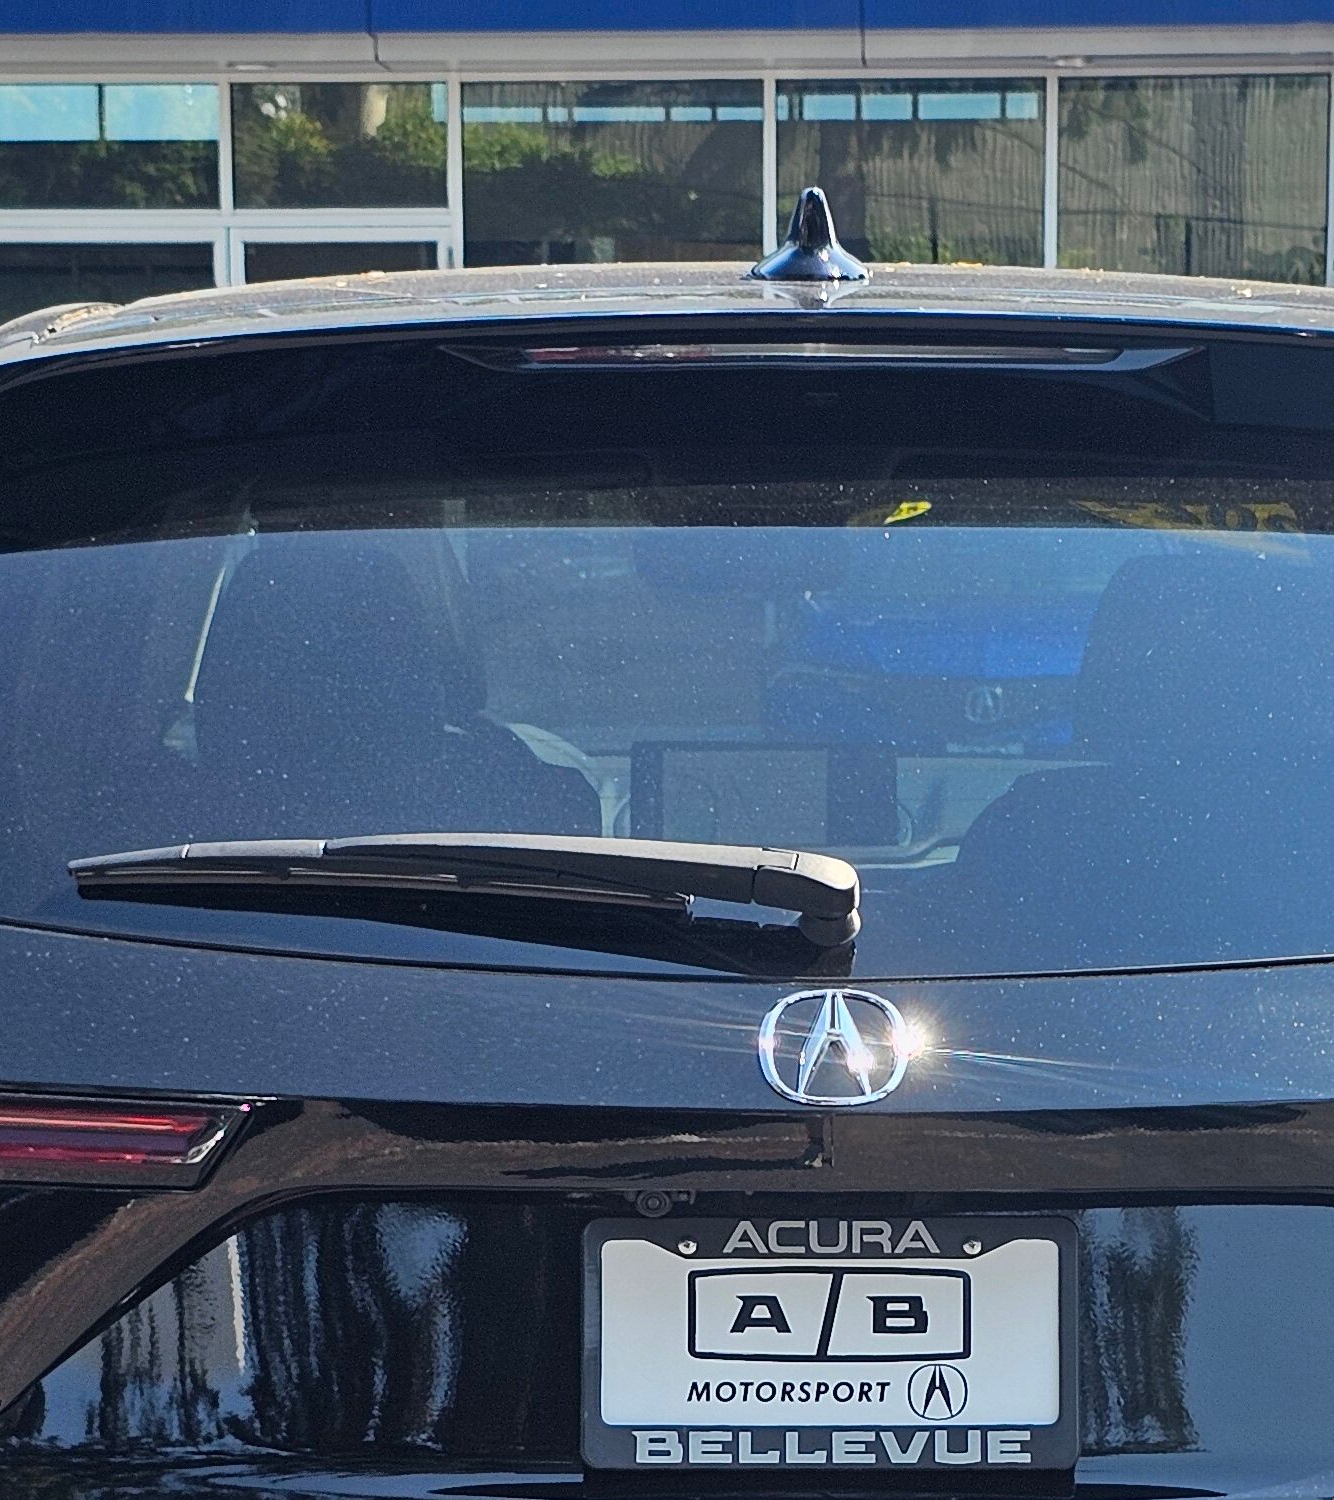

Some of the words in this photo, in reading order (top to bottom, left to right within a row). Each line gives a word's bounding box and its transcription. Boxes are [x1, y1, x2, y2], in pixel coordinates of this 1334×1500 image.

[722, 1220, 940, 1254] ACURA
[687, 1381, 891, 1403] MOTORSPORT
[632, 1430, 1032, 1464] BELLEVUE
